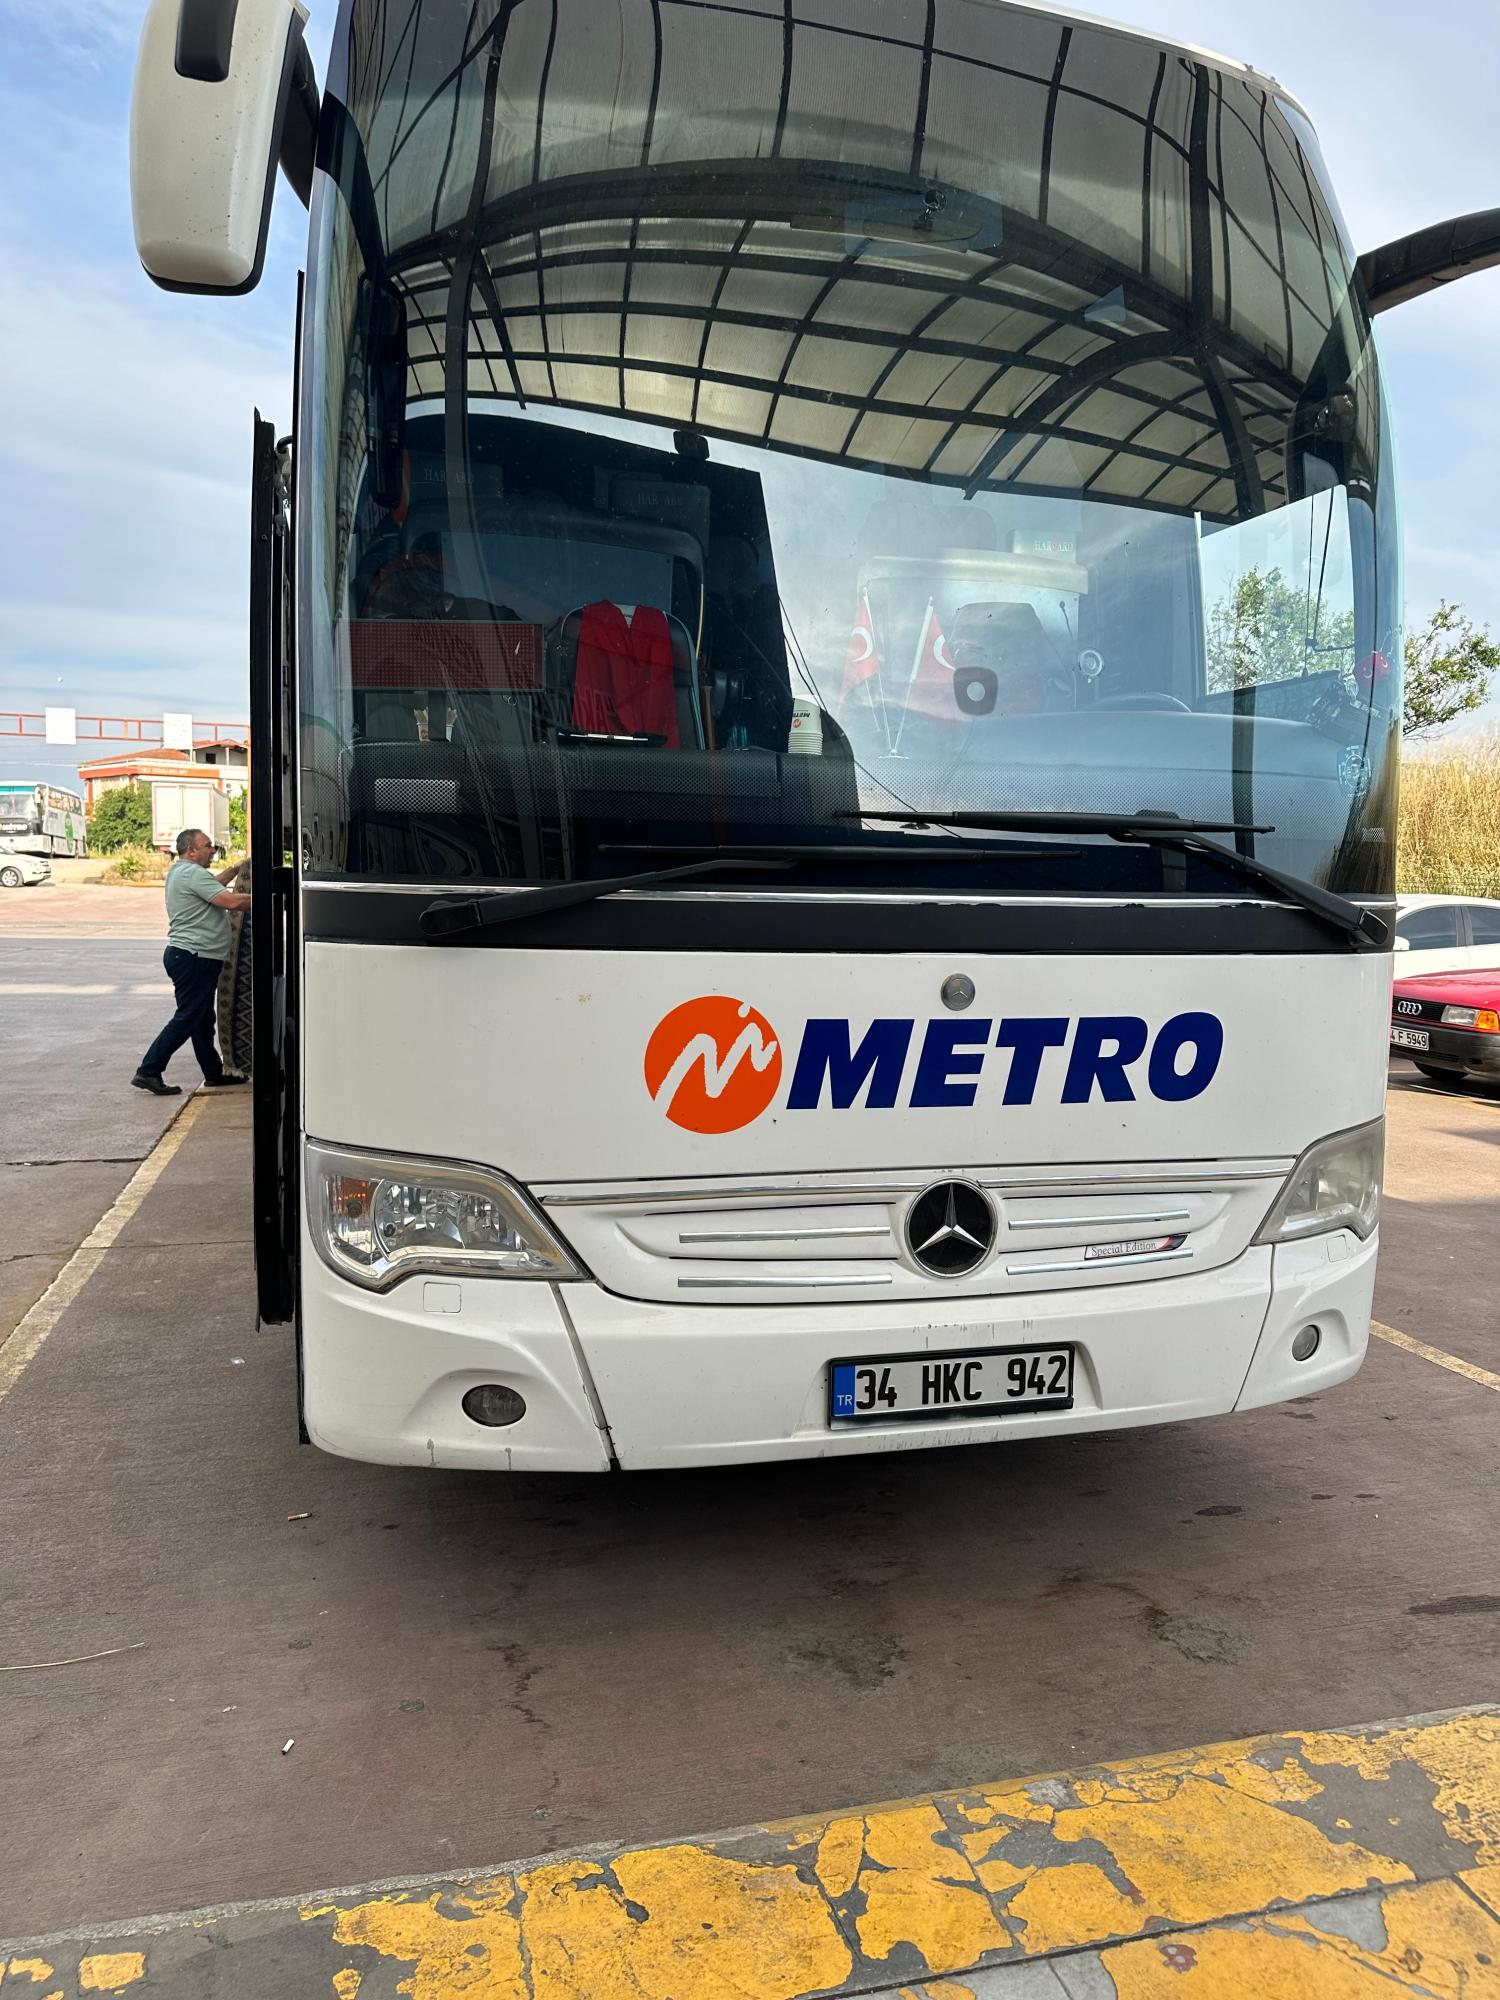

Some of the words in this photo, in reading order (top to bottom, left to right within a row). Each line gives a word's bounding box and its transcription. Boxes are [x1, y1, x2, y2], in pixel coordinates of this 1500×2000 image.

[1398, 1031, 1403, 1042] F
[1406, 1033, 1427, 1047] 5949
[786, 1011, 1224, 1110] METRO
[1091, 1243, 1123, 1258] Special
[1125, 1240, 1156, 1253] Edition
[856, 1367, 898, 1410] 34
[922, 1361, 983, 1405] HKC
[1007, 1355, 1067, 1397] 942
[837, 1394, 853, 1406] TR
